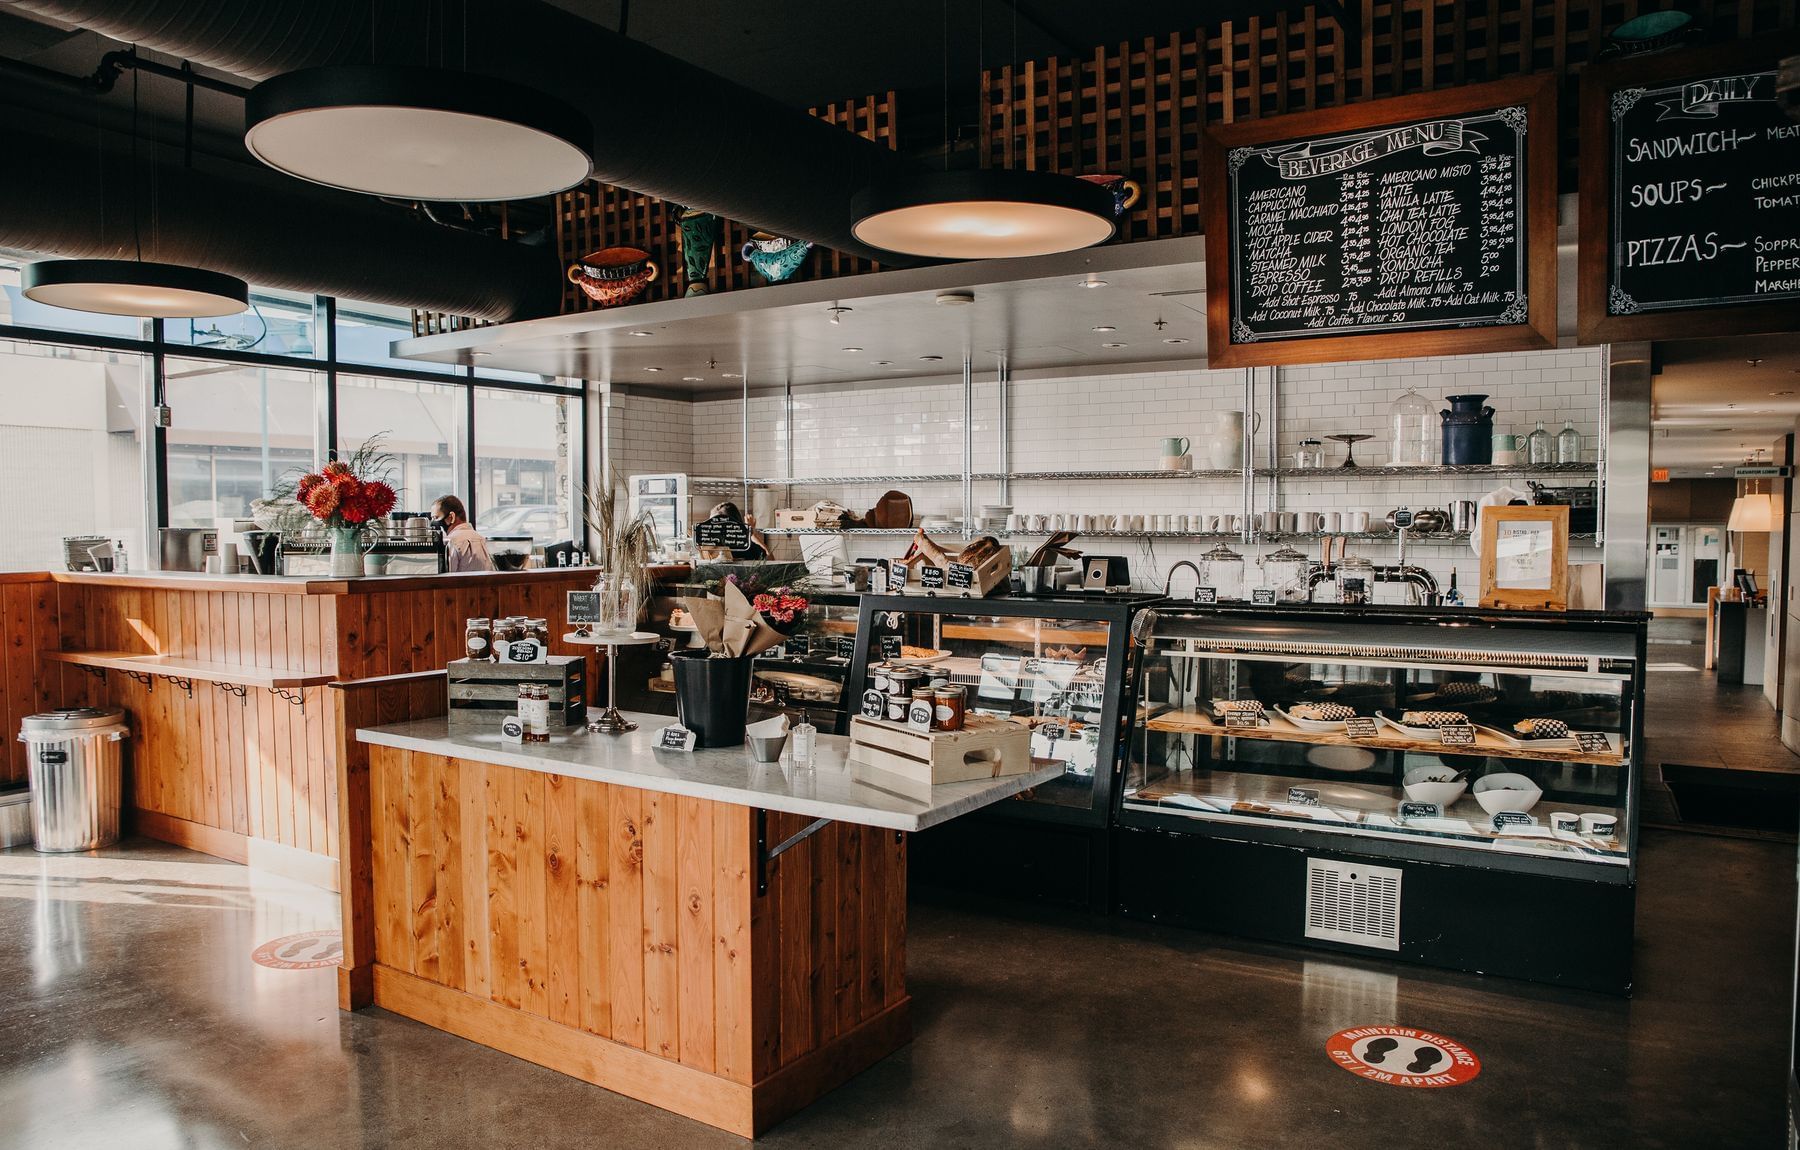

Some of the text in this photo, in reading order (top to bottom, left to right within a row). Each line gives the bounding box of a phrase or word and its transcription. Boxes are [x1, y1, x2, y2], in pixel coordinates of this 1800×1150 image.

[1690, 76, 1761, 105] DAILY
[1288, 123, 1444, 177] BEVERAGE MENU
[1380, 168, 1437, 185] AMERICANO
[1440, 164, 1472, 179] MISTO
[1248, 185, 1306, 202] AMERICANO
[1379, 183, 1414, 198] LATTE
[1380, 193, 1419, 210] VANILLA
[1422, 190, 1455, 205] LATTE
[1248, 196, 1306, 213] CAPPUCCINO
[1379, 208, 1405, 222] CHAI
[1407, 206, 1428, 220] TEA
[1428, 203, 1462, 218] LATTE
[1248, 210, 1287, 225] CARAMEL
[1288, 204, 1339, 220] MACCHIATO
[1248, 223, 1285, 237] MOCHA
[1381, 219, 1428, 236] LONDON
[1429, 216, 1456, 230] FOG
[1248, 236, 1272, 249] HOT
[1271, 234, 1301, 247] APPLE
[1304, 230, 1334, 244] CIDER
[1379, 234, 1404, 248] HOT
[1406, 227, 1470, 246] CHOCOLATE
[1248, 246, 1292, 261] MATCHA
[1380, 242, 1432, 260] ORGANIC
[1434, 241, 1456, 255] TEA
[1250, 257, 1297, 273] STEAMED
[1298, 254, 1327, 269] MILK
[1380, 255, 1444, 273] KOMBUCHA
[1250, 268, 1310, 285] ESPRESSO
[1380, 271, 1410, 286] DRIP
[1414, 266, 1463, 283] REFILLS
[1251, 284, 1278, 297] DRIP
[1282, 279, 1326, 295] COFFEE
[1399, 285, 1432, 297] Almond
[1434, 282, 1456, 294] Milk
[1269, 309, 1302, 320] Coconut
[1303, 306, 1321, 318] Milk
[1366, 299, 1406, 312] Chocolate
[1407, 298, 1426, 309] Milk
[1464, 294, 1480, 305] Oat
[1480, 291, 1500, 303] Milk
[1282, 294, 1301, 307] Shot
[1301, 293, 1340, 306] Espresso
[1328, 313, 1354, 327] Coffee
[1356, 312, 1389, 324] Flavour
[1342, 1027, 1475, 1067] MAINTAIN DISTANCE
[1332, 1050, 1358, 1065] 6FT
[1363, 1069, 1393, 1082] 2M
[1400, 1073, 1457, 1085] APART
